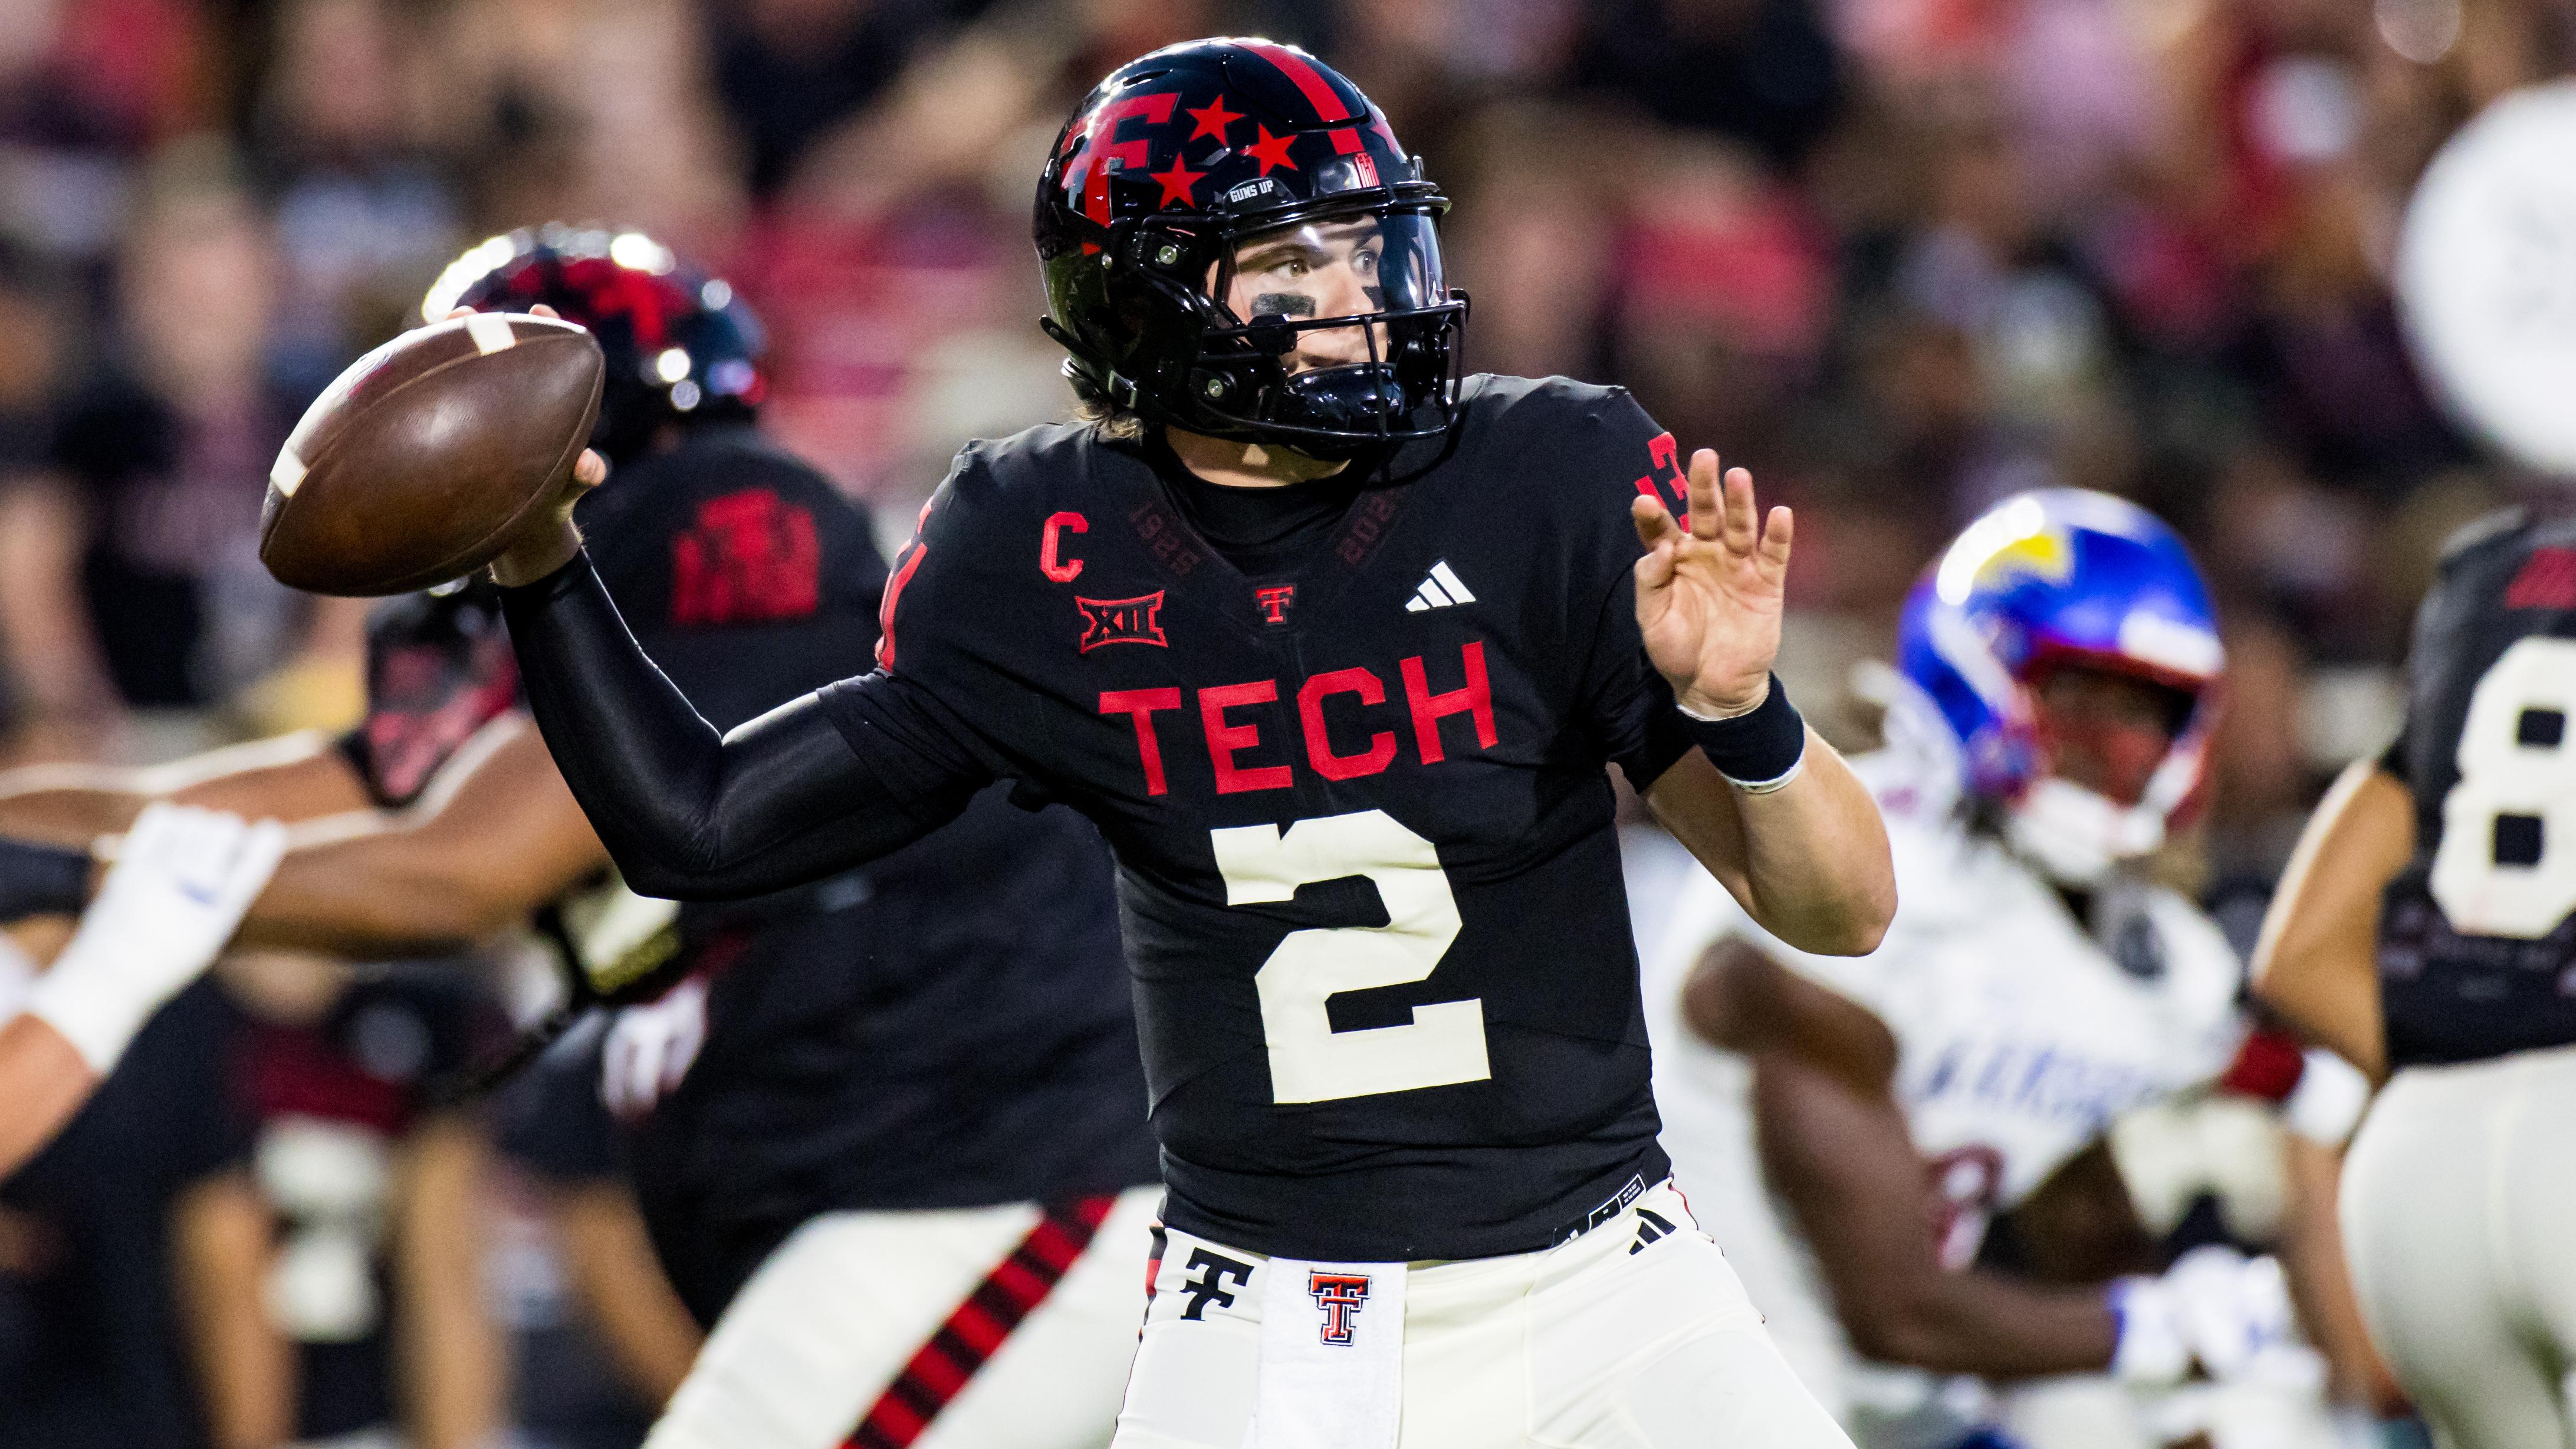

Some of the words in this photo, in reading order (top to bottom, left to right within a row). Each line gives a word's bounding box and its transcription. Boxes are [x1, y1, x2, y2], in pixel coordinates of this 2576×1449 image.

[1229, 184, 1257, 203] GUNS
[1258, 180, 1274, 195] UP
[1040, 511, 1089, 582] C
[1128, 502, 1201, 576] 1925
[1080, 598, 1161, 647] XII
[1099, 641, 1499, 796] TECH
[1210, 809, 1491, 1103] 2
